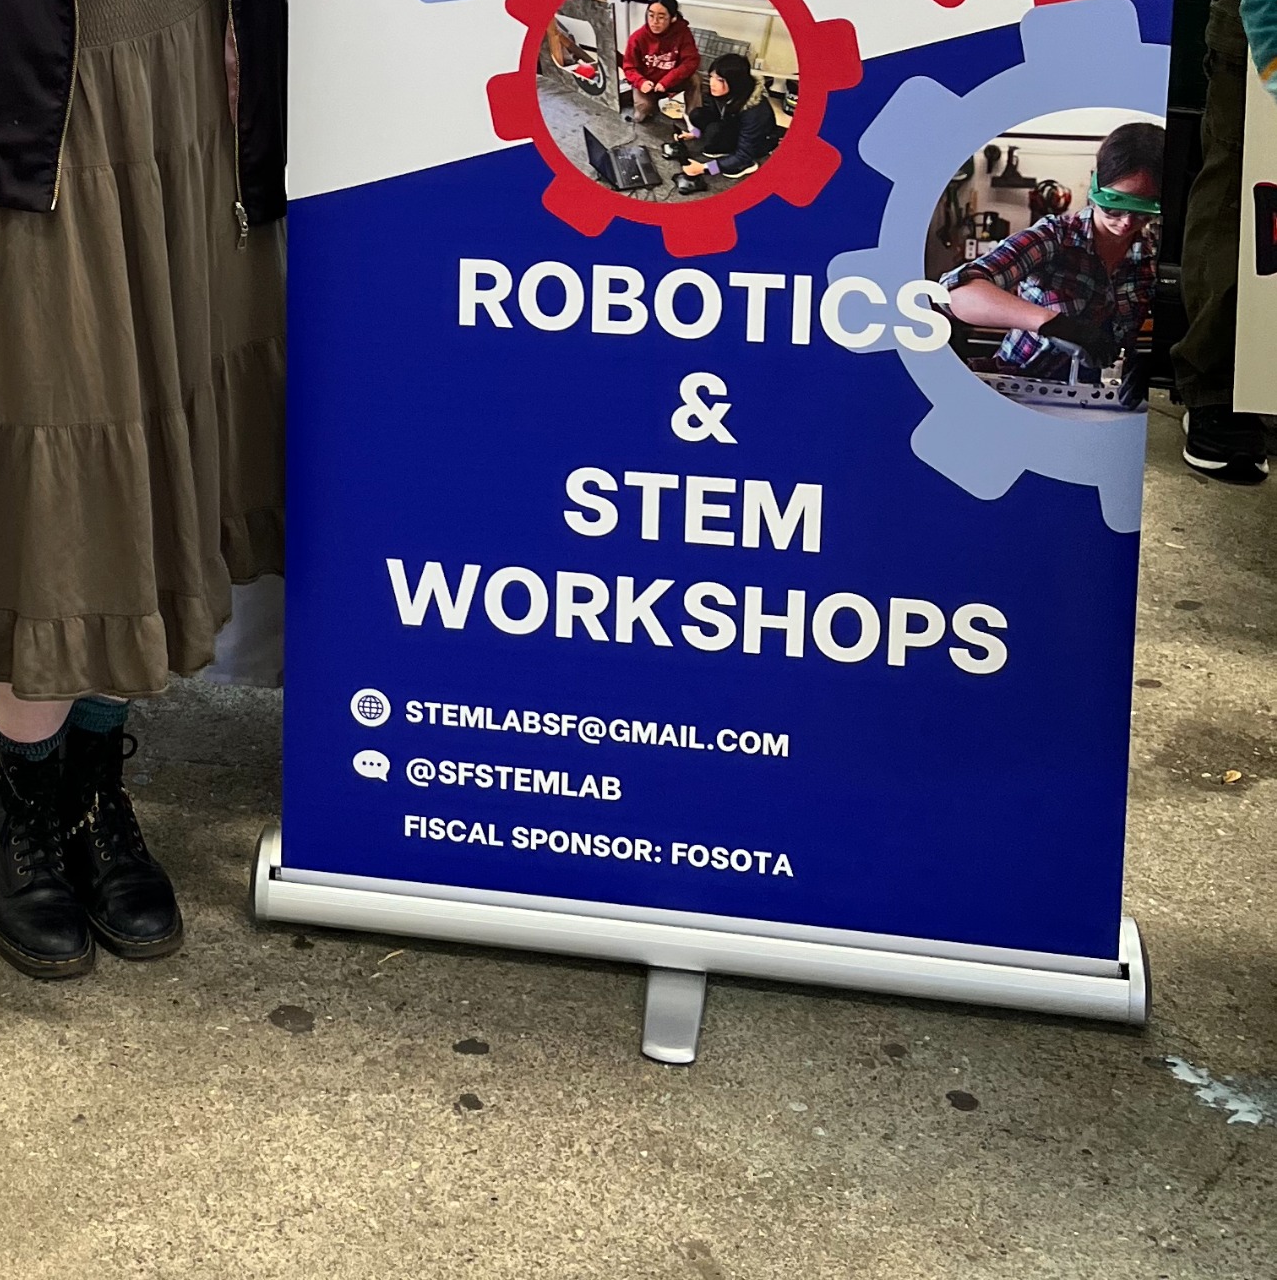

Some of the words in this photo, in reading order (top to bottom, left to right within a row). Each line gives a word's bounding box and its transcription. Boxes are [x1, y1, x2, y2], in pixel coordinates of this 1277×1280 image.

[458, 258, 952, 352] ROBOTICS
[671, 371, 738, 444] &
[563, 466, 823, 553] STEM
[386, 557, 1009, 675] WORKSHOPS
[405, 700, 789, 757] STEMLABSF@GMAIL.COM
[405, 757, 622, 801] @SFSTEMLAB
[404, 815, 504, 847] FISCAL
[511, 826, 662, 864] SPONSOR:
[671, 842, 794, 877] FOSOTA
